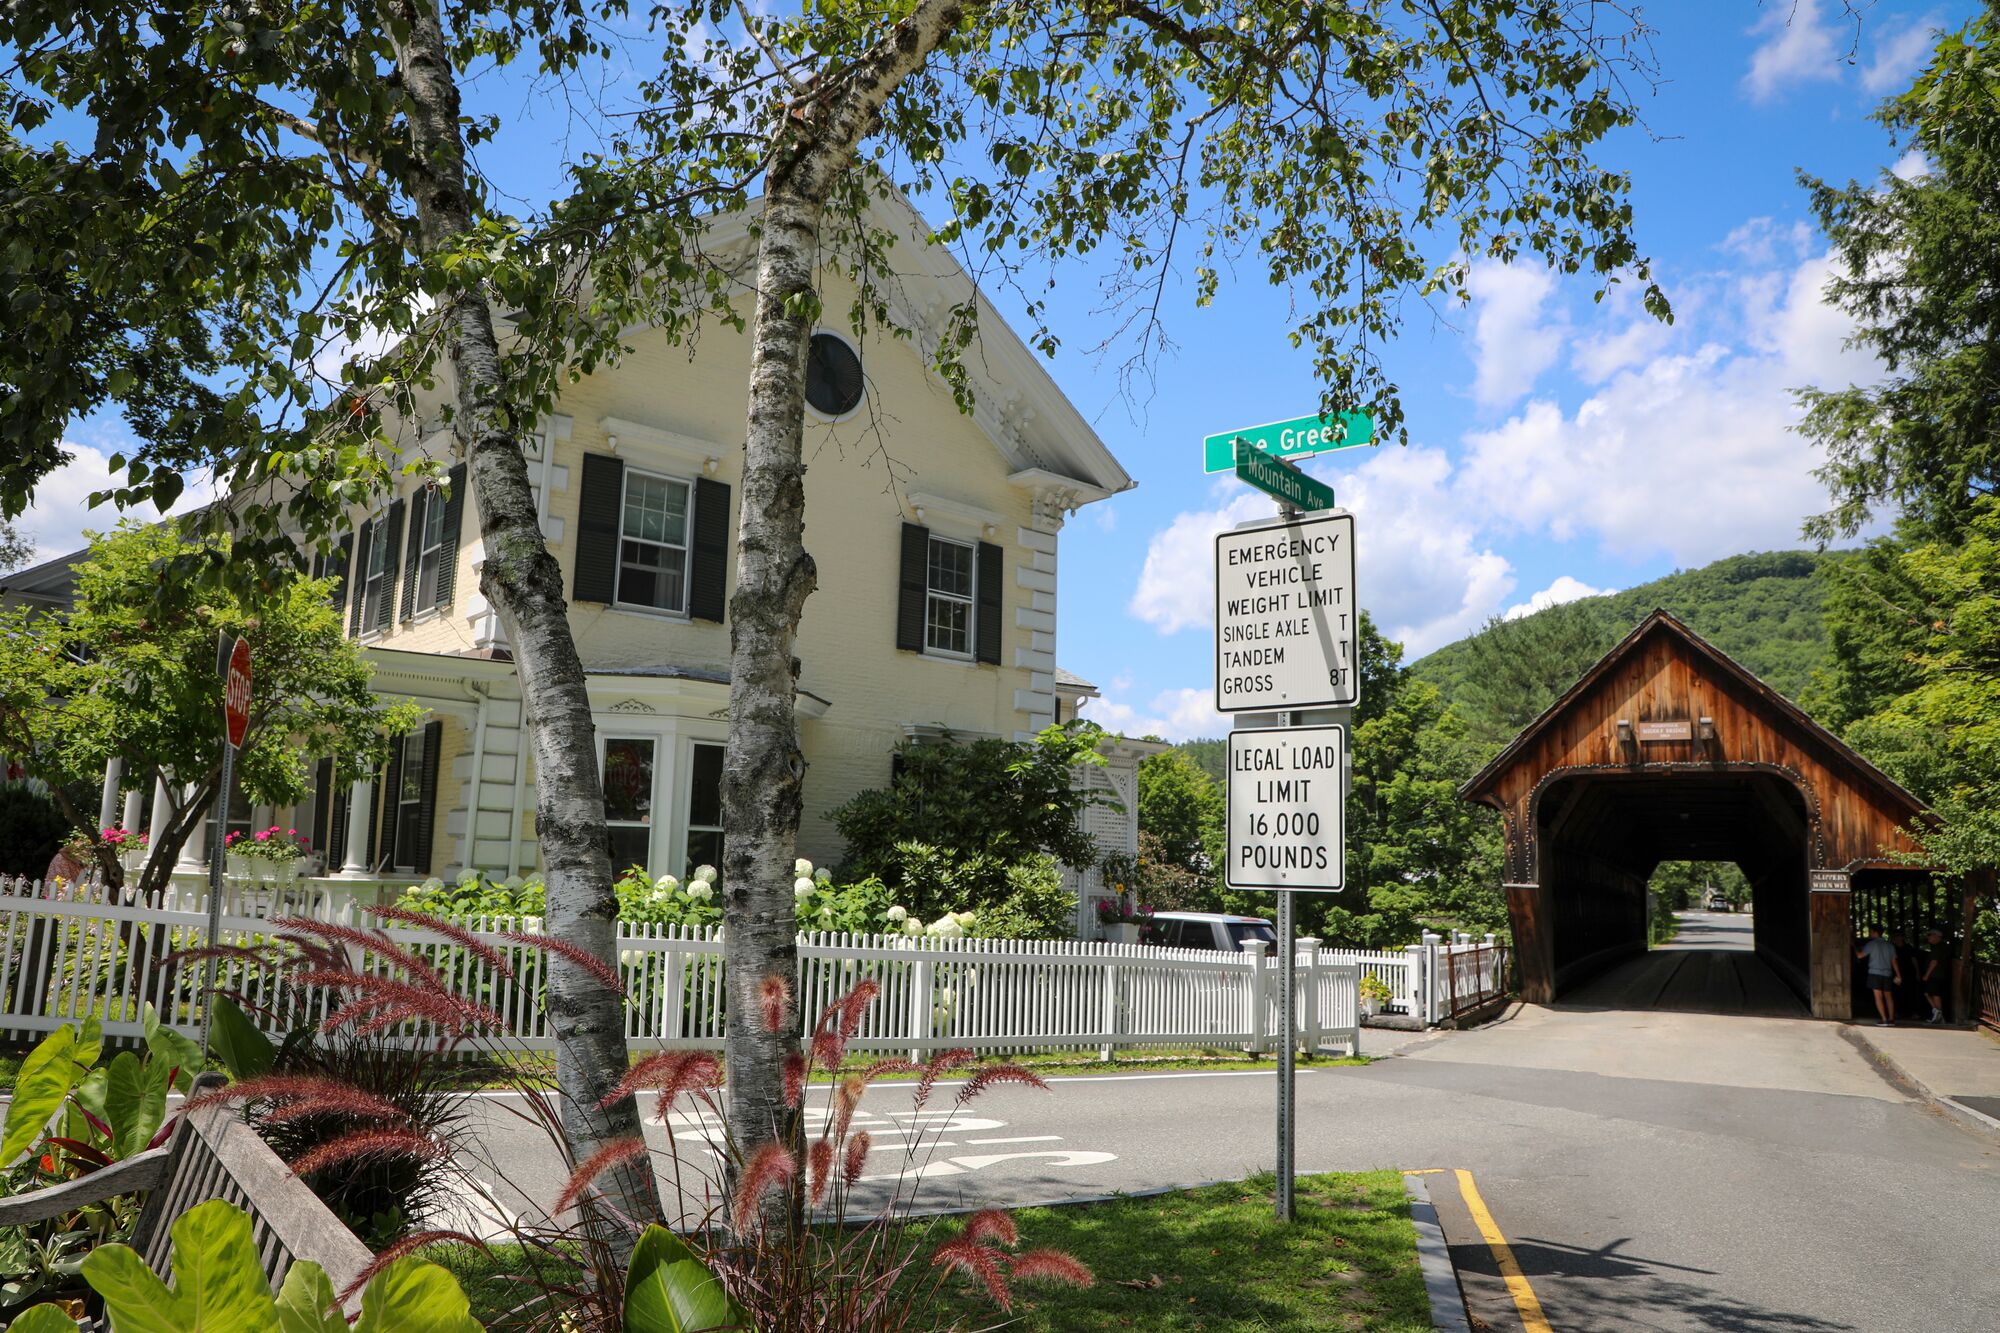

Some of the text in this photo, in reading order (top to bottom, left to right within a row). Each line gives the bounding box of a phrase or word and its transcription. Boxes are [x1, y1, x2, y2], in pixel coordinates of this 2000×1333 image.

[1228, 423, 1348, 460] Te Green
[1248, 453, 1324, 510] Mountain Ave
[1229, 534, 1339, 566] EMERGENCY
[1246, 563, 1323, 589] VEHICLE
[1228, 587, 1343, 616] WEIGHT LIMIT
[1224, 614, 1347, 643] SINGLE AXLE T
[1224, 640, 1348, 668] TANDEM T
[228, 666, 251, 717] STOP
[1224, 668, 1348, 694] GROSS 8T
[1235, 746, 1335, 771] LEGAL LOAD
[1257, 780, 1311, 803] LIMIT
[1249, 812, 1319, 839] 16,000
[1241, 845, 1328, 869] POUNDS
